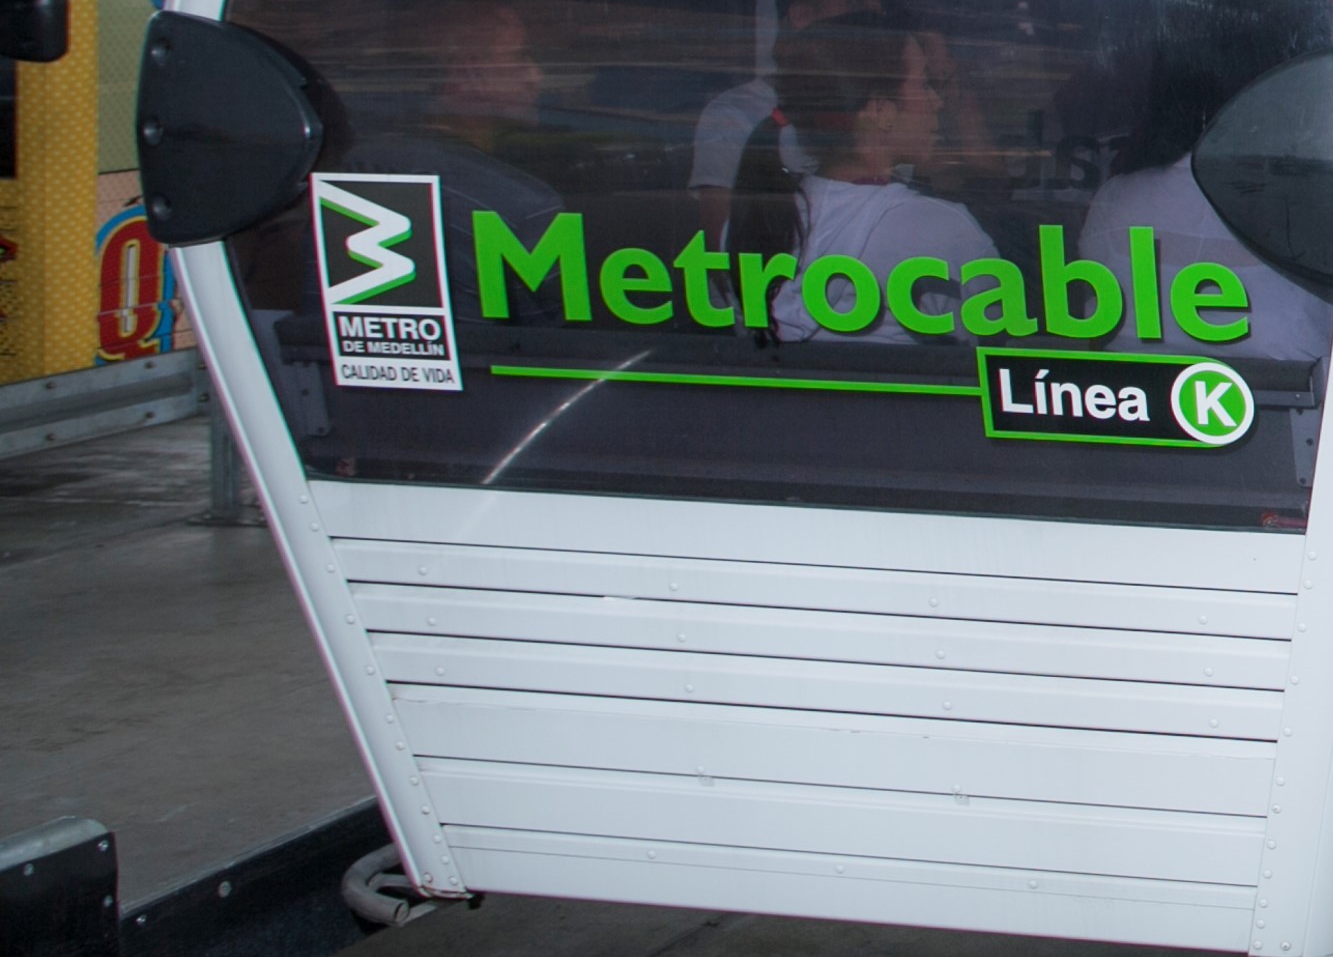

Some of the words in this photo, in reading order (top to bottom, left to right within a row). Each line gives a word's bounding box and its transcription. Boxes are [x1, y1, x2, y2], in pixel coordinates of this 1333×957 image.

[470, 209, 1251, 342] Metrocable
[338, 316, 441, 341] METRO
[342, 340, 365, 353] DE
[367, 340, 445, 356] MEDELLÍN
[341, 363, 398, 382] CALIDAD
[401, 366, 420, 382] DE
[422, 367, 456, 384] VIDA
[998, 368, 1150, 422] Línea
[1194, 379, 1238, 428] K
